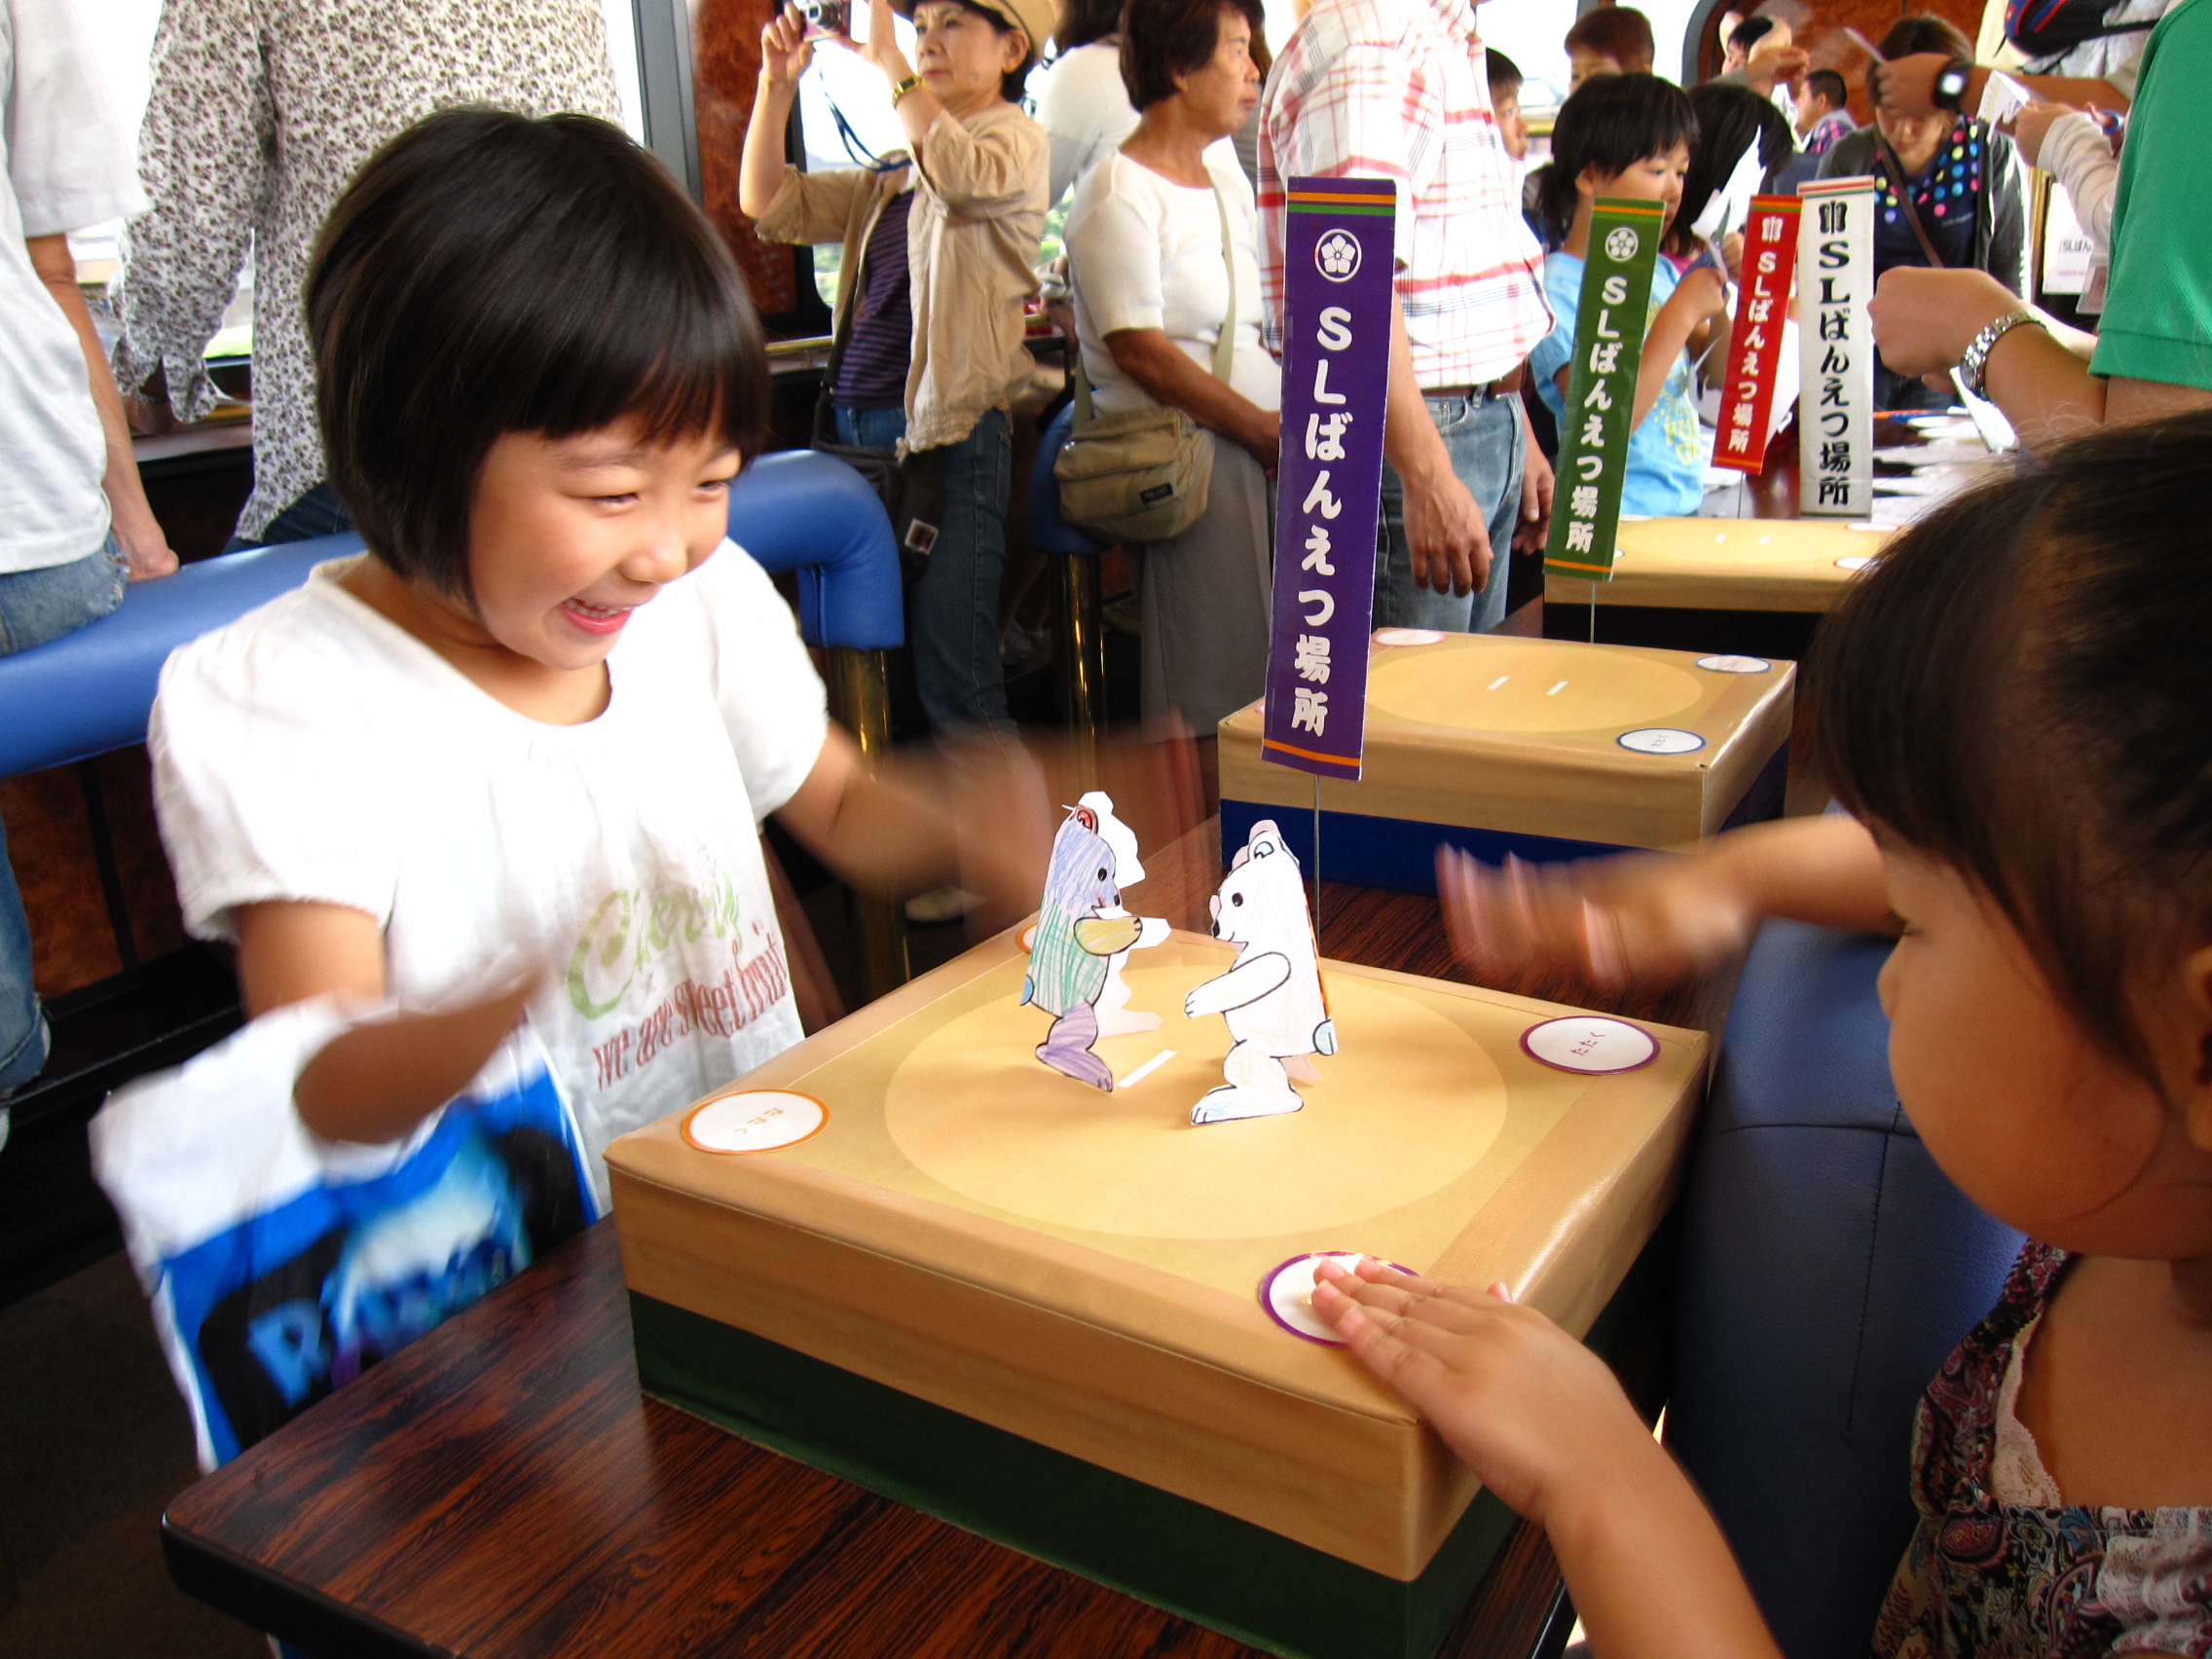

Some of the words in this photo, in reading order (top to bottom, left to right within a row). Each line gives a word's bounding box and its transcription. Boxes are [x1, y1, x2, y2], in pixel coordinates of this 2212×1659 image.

[1565, 275, 1629, 555] SLばんえつ場所
[1727, 250, 1777, 455] SLばんえつ場所
[1818, 240, 1851, 506] SLばんえつ場所
[1290, 305, 1354, 739] SLばんえつ場所
[1569, 1031, 1606, 1056] たたく
